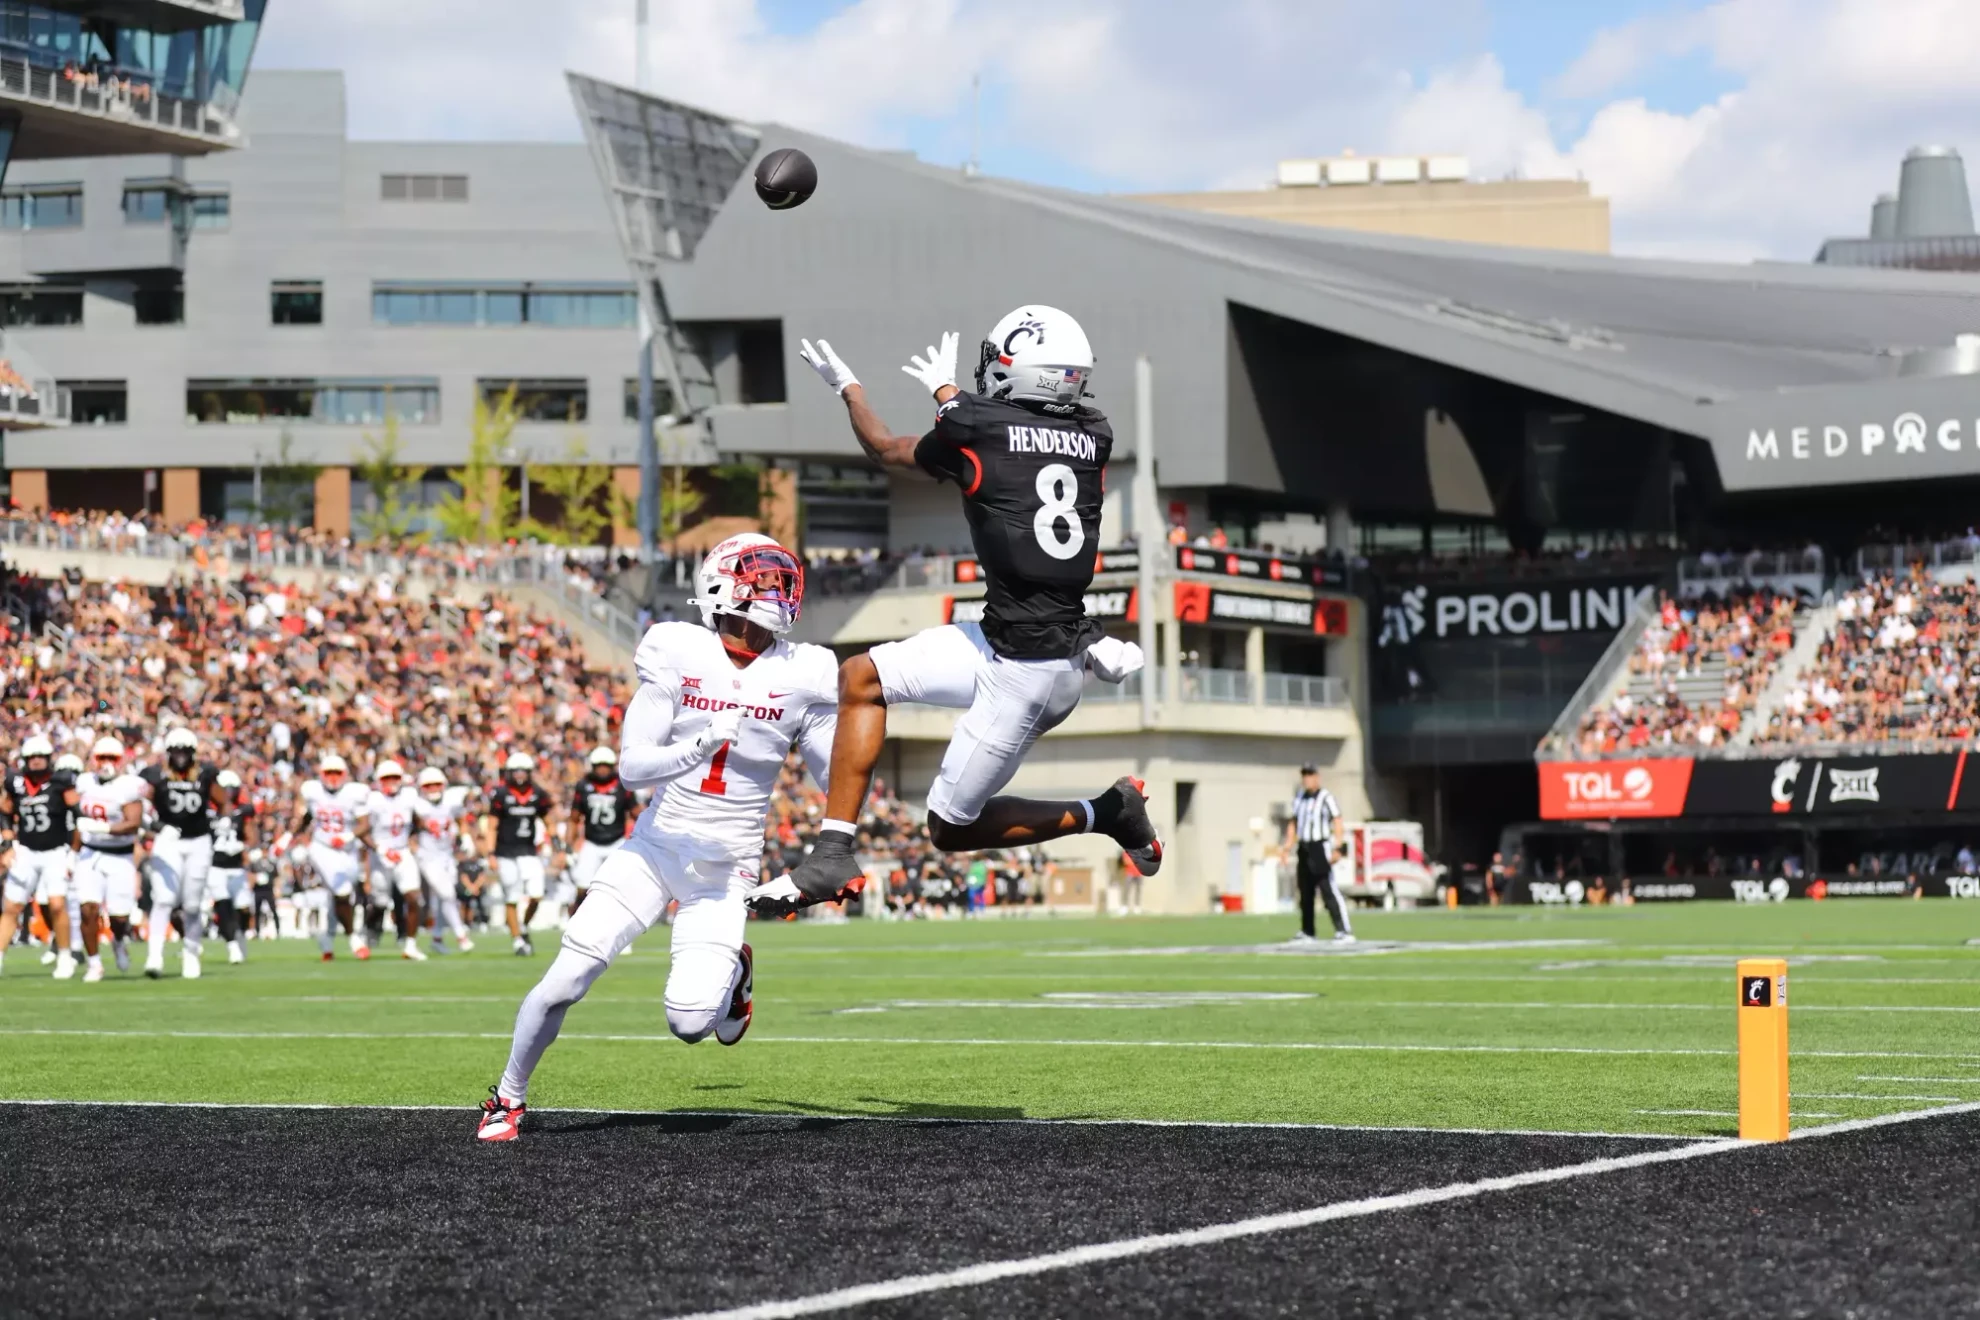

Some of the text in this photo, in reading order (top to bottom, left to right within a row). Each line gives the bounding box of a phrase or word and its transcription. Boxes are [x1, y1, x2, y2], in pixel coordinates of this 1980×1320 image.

[1008, 426, 1096, 462] HENDERSON
[1747, 412, 1980, 460] MEDPAC
[1033, 463, 1085, 560] 8
[1435, 584, 1655, 637] PROLINK
[700, 739, 730, 796] 1
[1563, 771, 1622, 801] TQL
[19, 803, 51, 833] 53
[588, 801, 617, 825] 75
[1529, 881, 1566, 904] TQL
[1731, 879, 1770, 902] TQL
